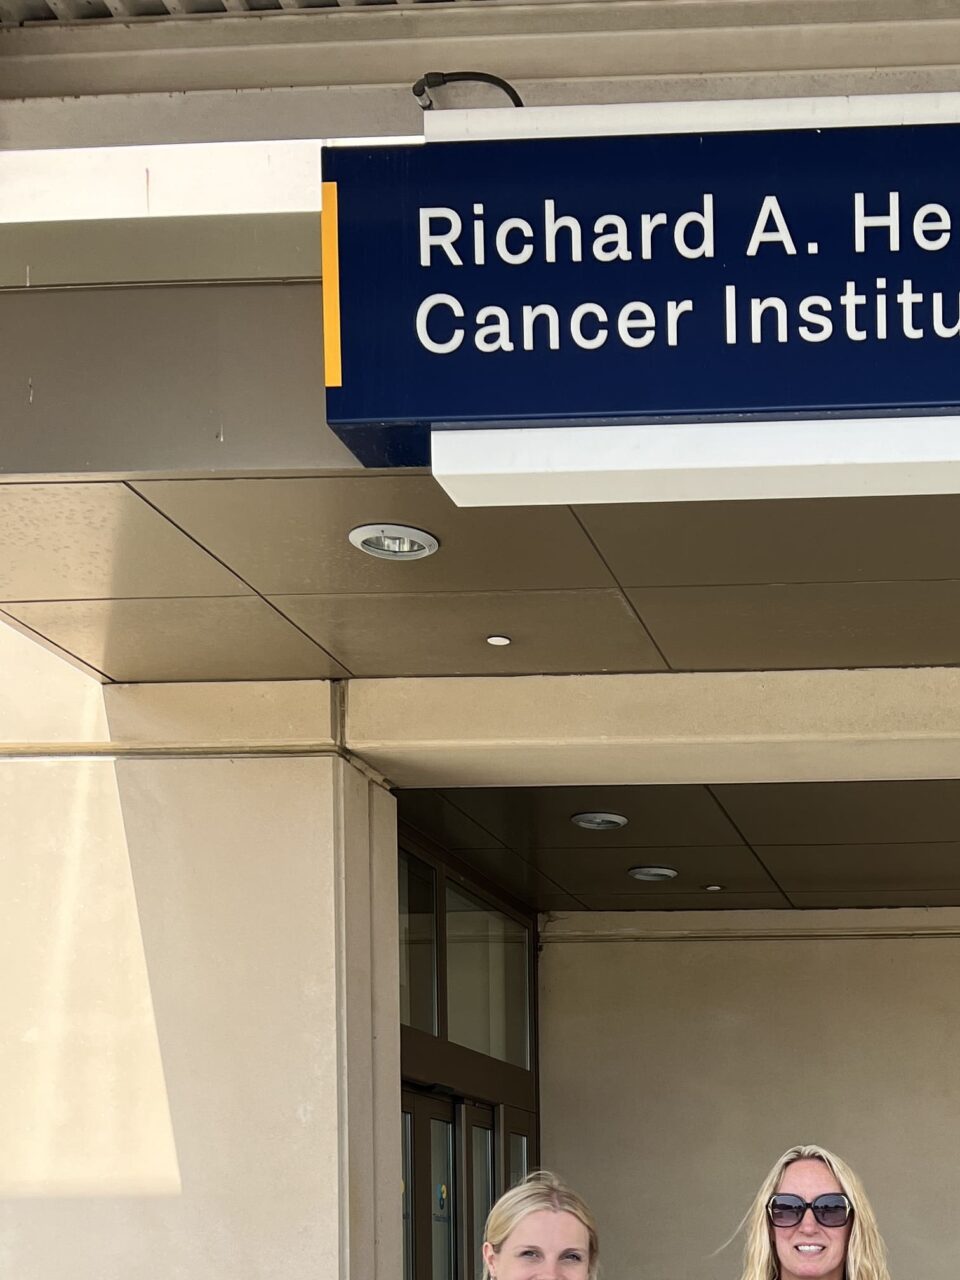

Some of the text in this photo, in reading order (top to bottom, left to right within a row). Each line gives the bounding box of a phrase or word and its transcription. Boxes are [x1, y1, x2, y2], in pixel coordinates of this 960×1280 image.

[419, 193, 715, 267] Richard
[746, 195, 819, 256] A.
[415, 293, 693, 354] Cancer
